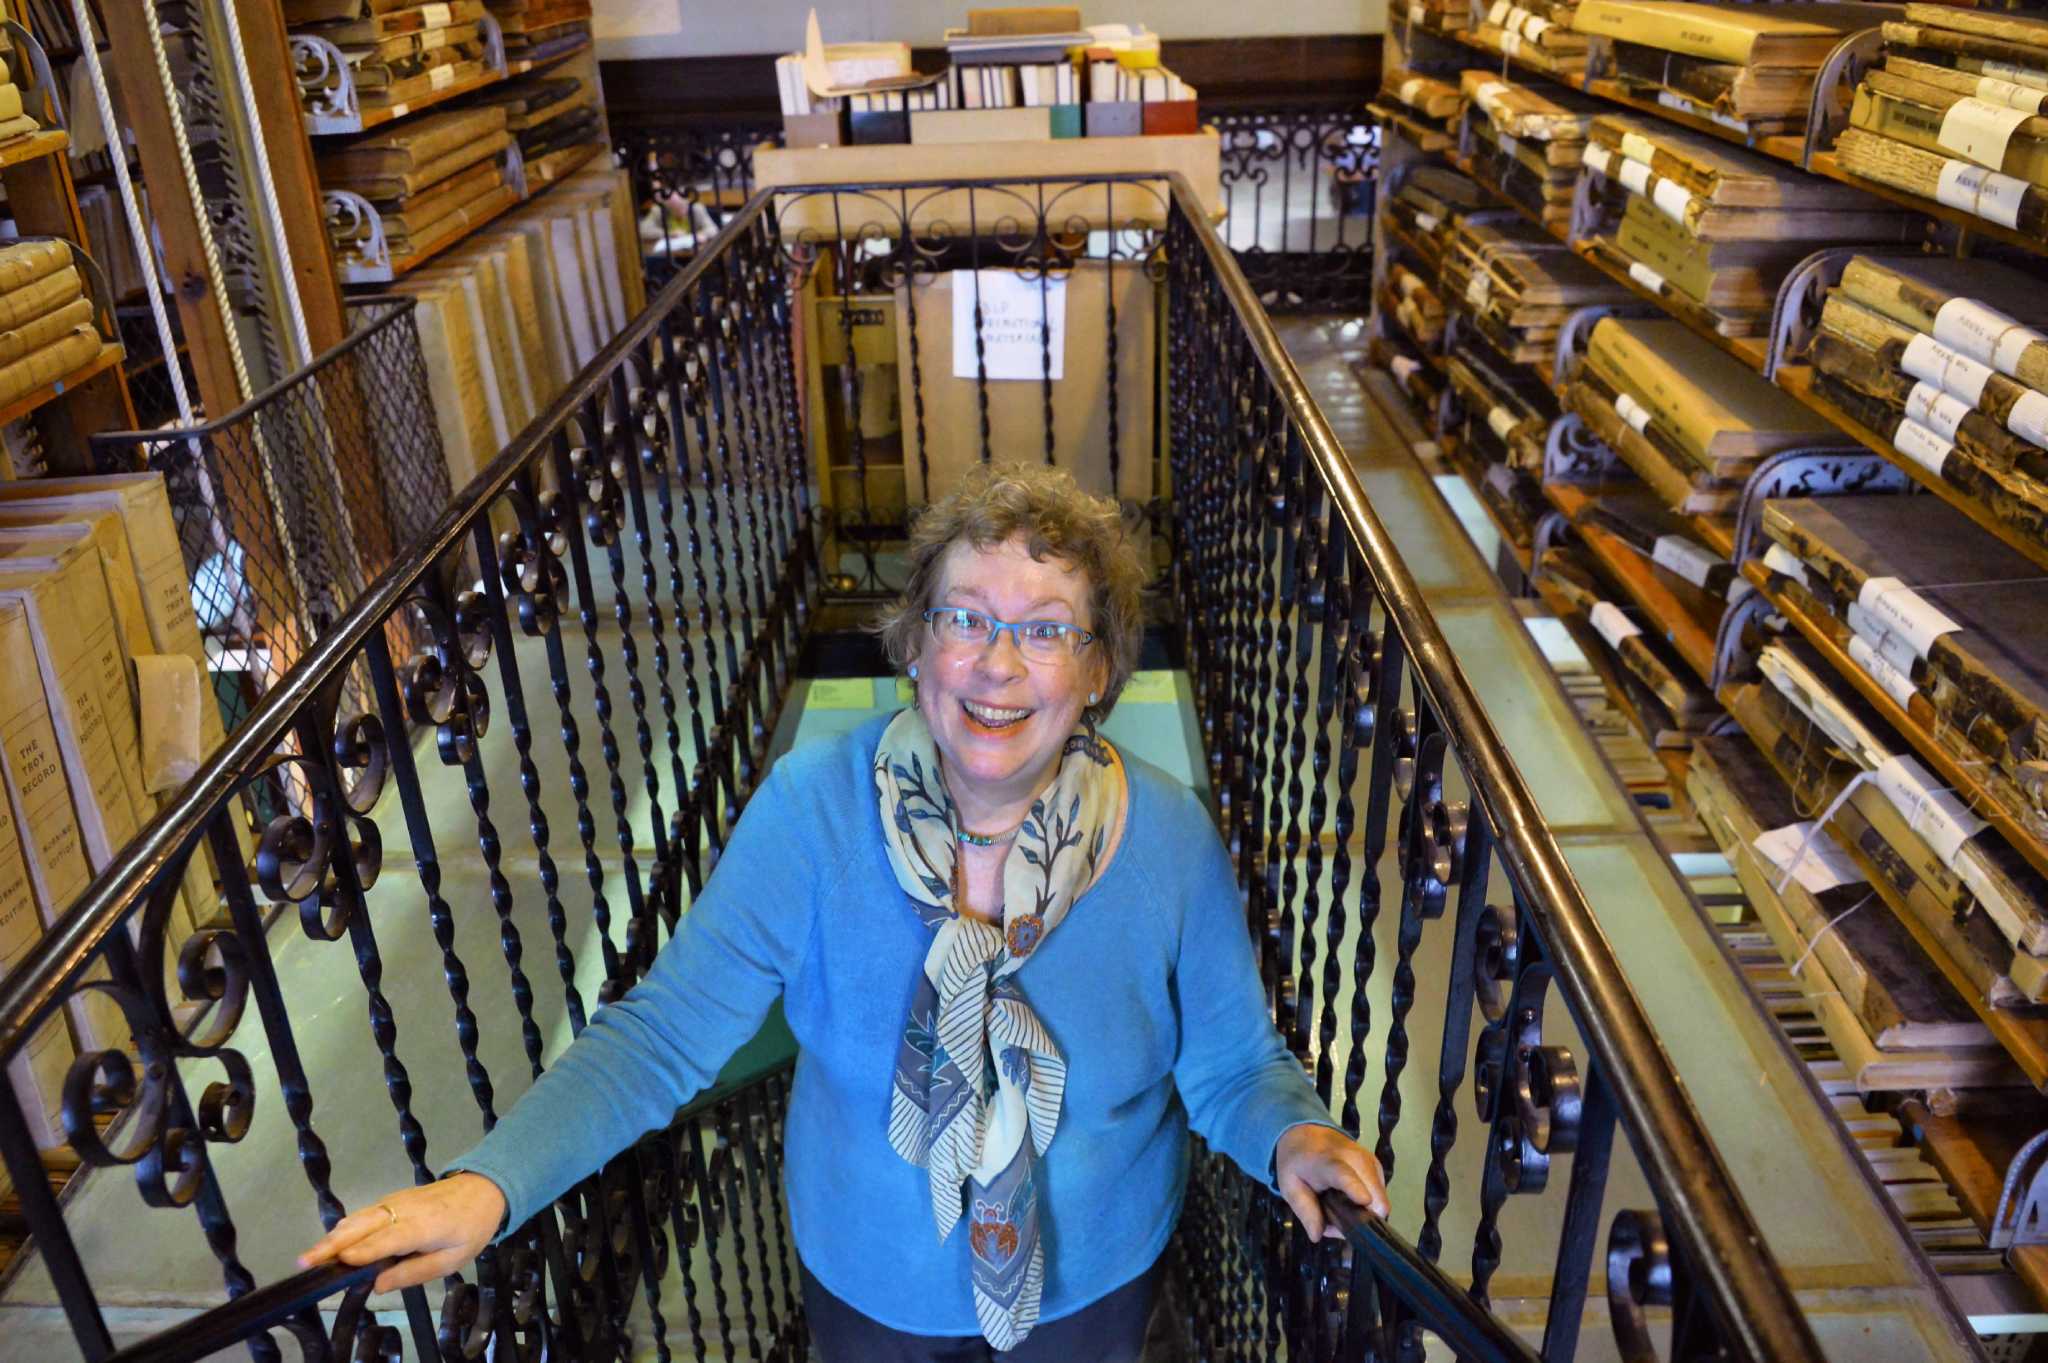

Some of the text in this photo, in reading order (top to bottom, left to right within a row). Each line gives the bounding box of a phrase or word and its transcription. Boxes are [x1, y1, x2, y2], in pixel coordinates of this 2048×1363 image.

[19, 738, 39, 760] THE
[21, 751, 45, 778] TROY
[21, 762, 57, 796] RECORD
